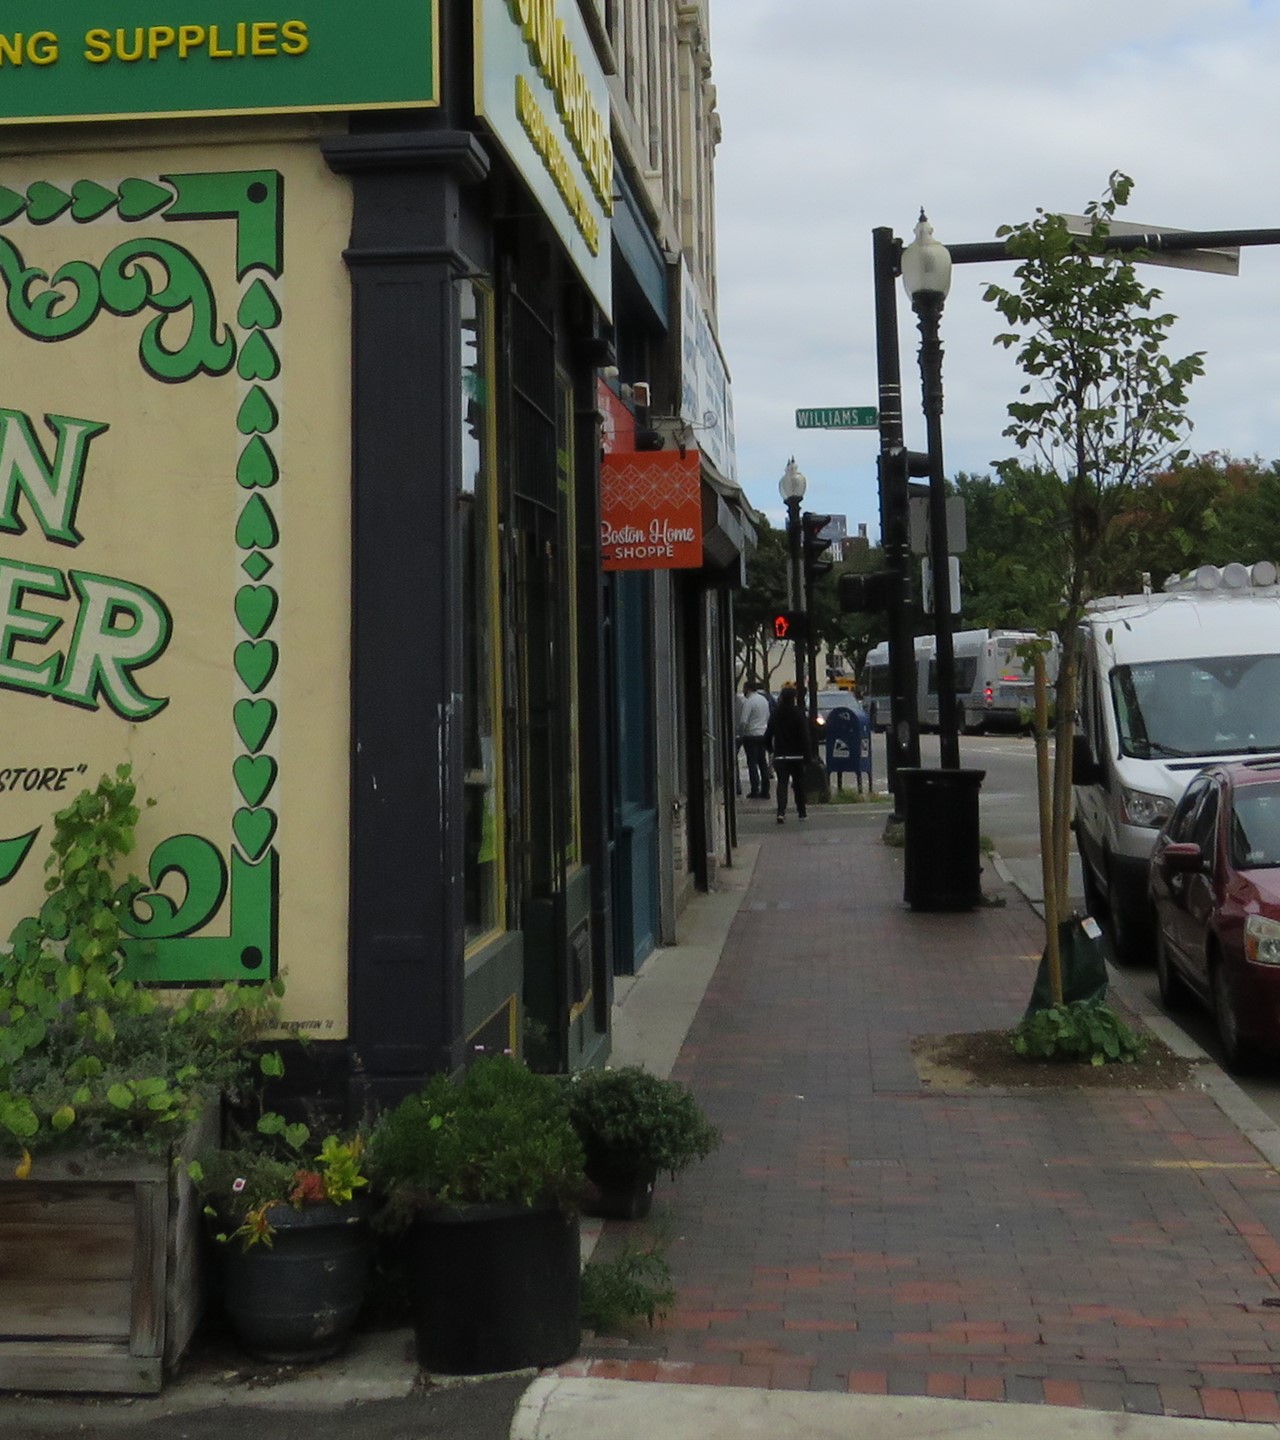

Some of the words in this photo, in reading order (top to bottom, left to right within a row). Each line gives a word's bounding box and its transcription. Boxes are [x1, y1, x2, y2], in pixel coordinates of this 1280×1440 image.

[83, 19, 310, 63] SUPPLIES
[798, 410, 859, 427] WILLIAMS
[601, 520, 646, 546] Boston
[649, 518, 696, 546] Home
[615, 545, 674, 559] SHOPPE
